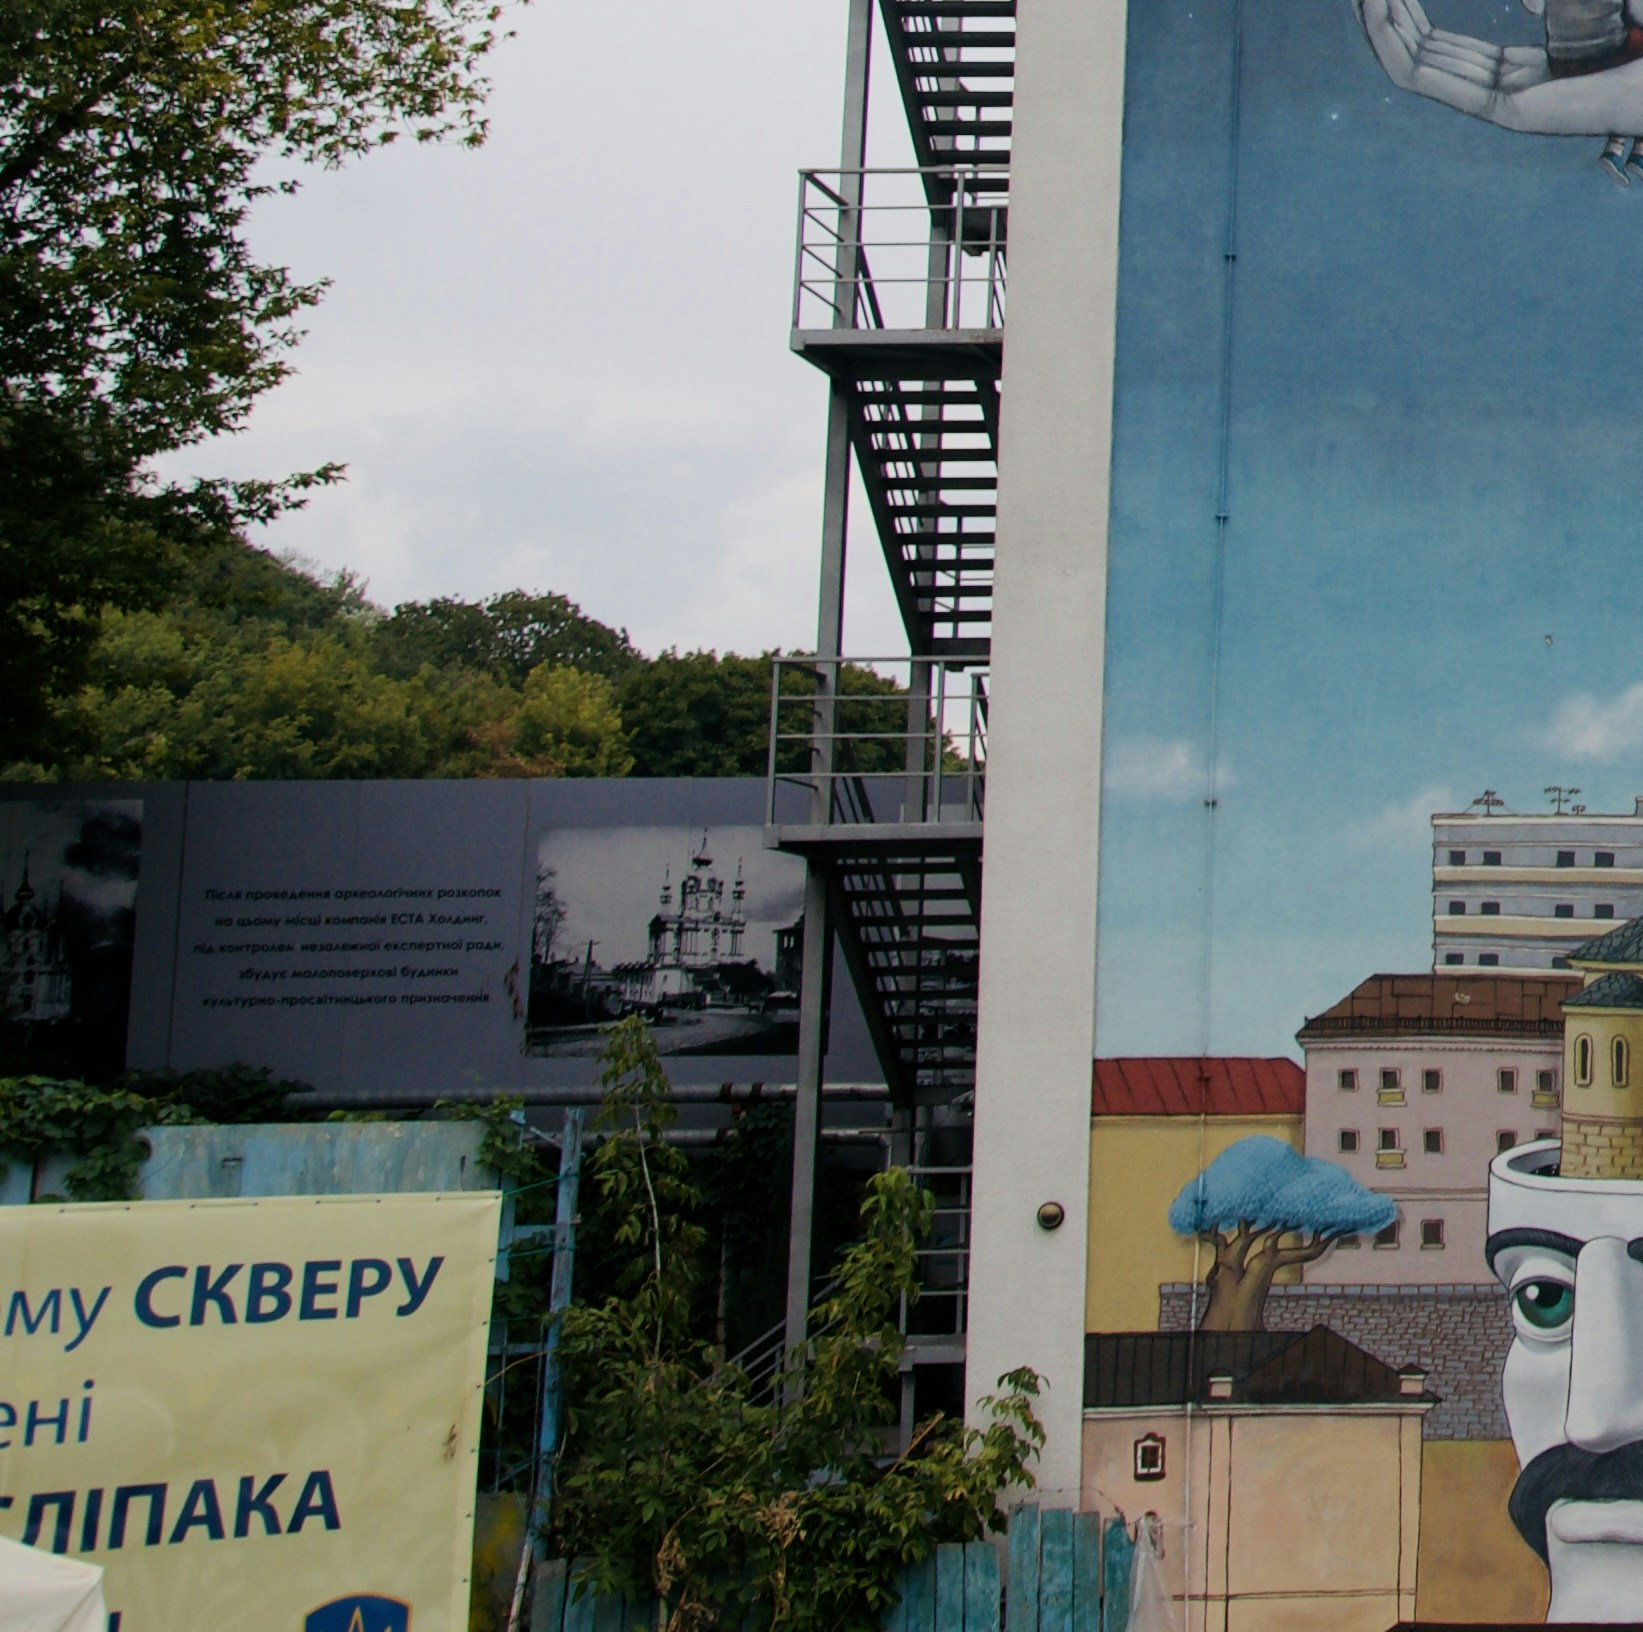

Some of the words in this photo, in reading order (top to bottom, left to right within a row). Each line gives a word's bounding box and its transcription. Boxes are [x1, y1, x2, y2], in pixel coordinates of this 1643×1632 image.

[246, 889, 331, 902] проведення
[437, 888, 502, 900] розкопок
[236, 917, 282, 929] цьому
[285, 914, 322, 927] місці
[325, 914, 387, 926] компанія
[391, 913, 424, 925] ЕСТА
[384, 940, 463, 953] експертної
[400, 966, 459, 979] будинки
[134, 1256, 445, 1328] СКВЕРУ
[0, 1470, 341, 1555] ЛІПАКА
